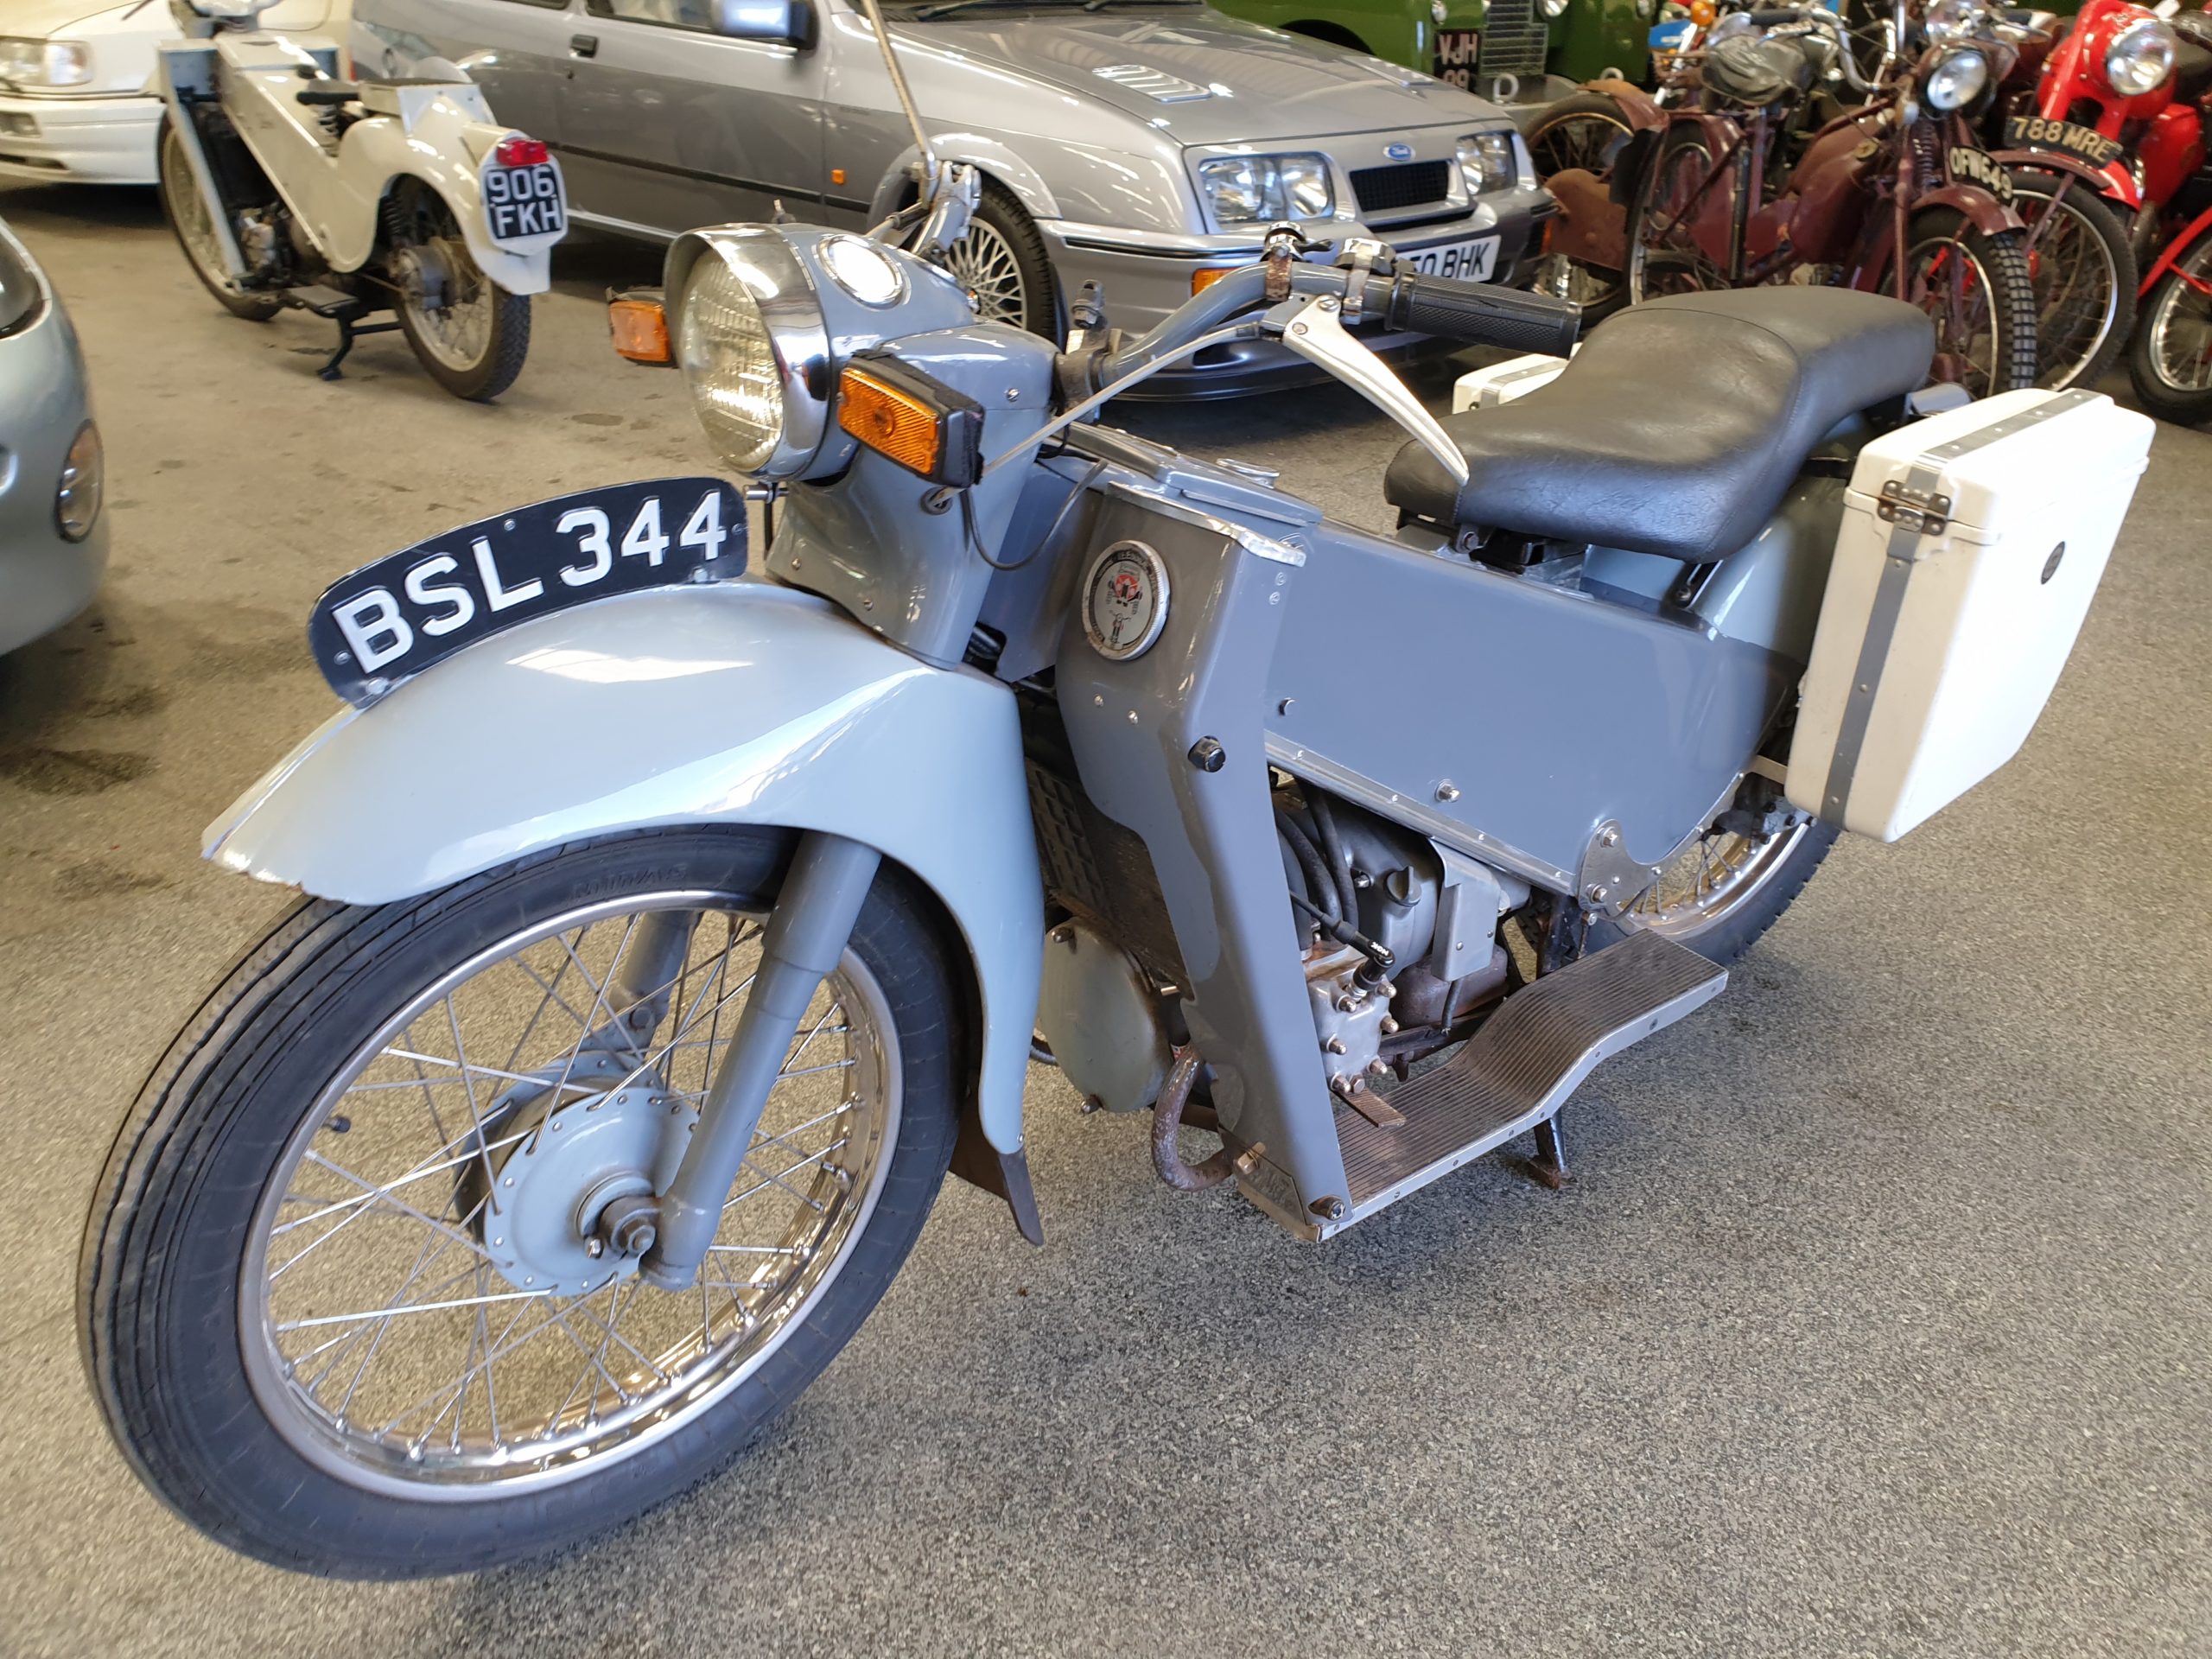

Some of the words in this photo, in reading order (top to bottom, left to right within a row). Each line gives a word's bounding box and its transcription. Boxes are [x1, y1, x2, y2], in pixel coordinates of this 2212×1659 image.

[1439, 33, 1478, 65] VJH
[486, 166, 555, 203] 906
[495, 199, 563, 237] FKH
[1441, 243, 1491, 278] BHK
[332, 537, 544, 675] BSL
[556, 489, 728, 588] 344
